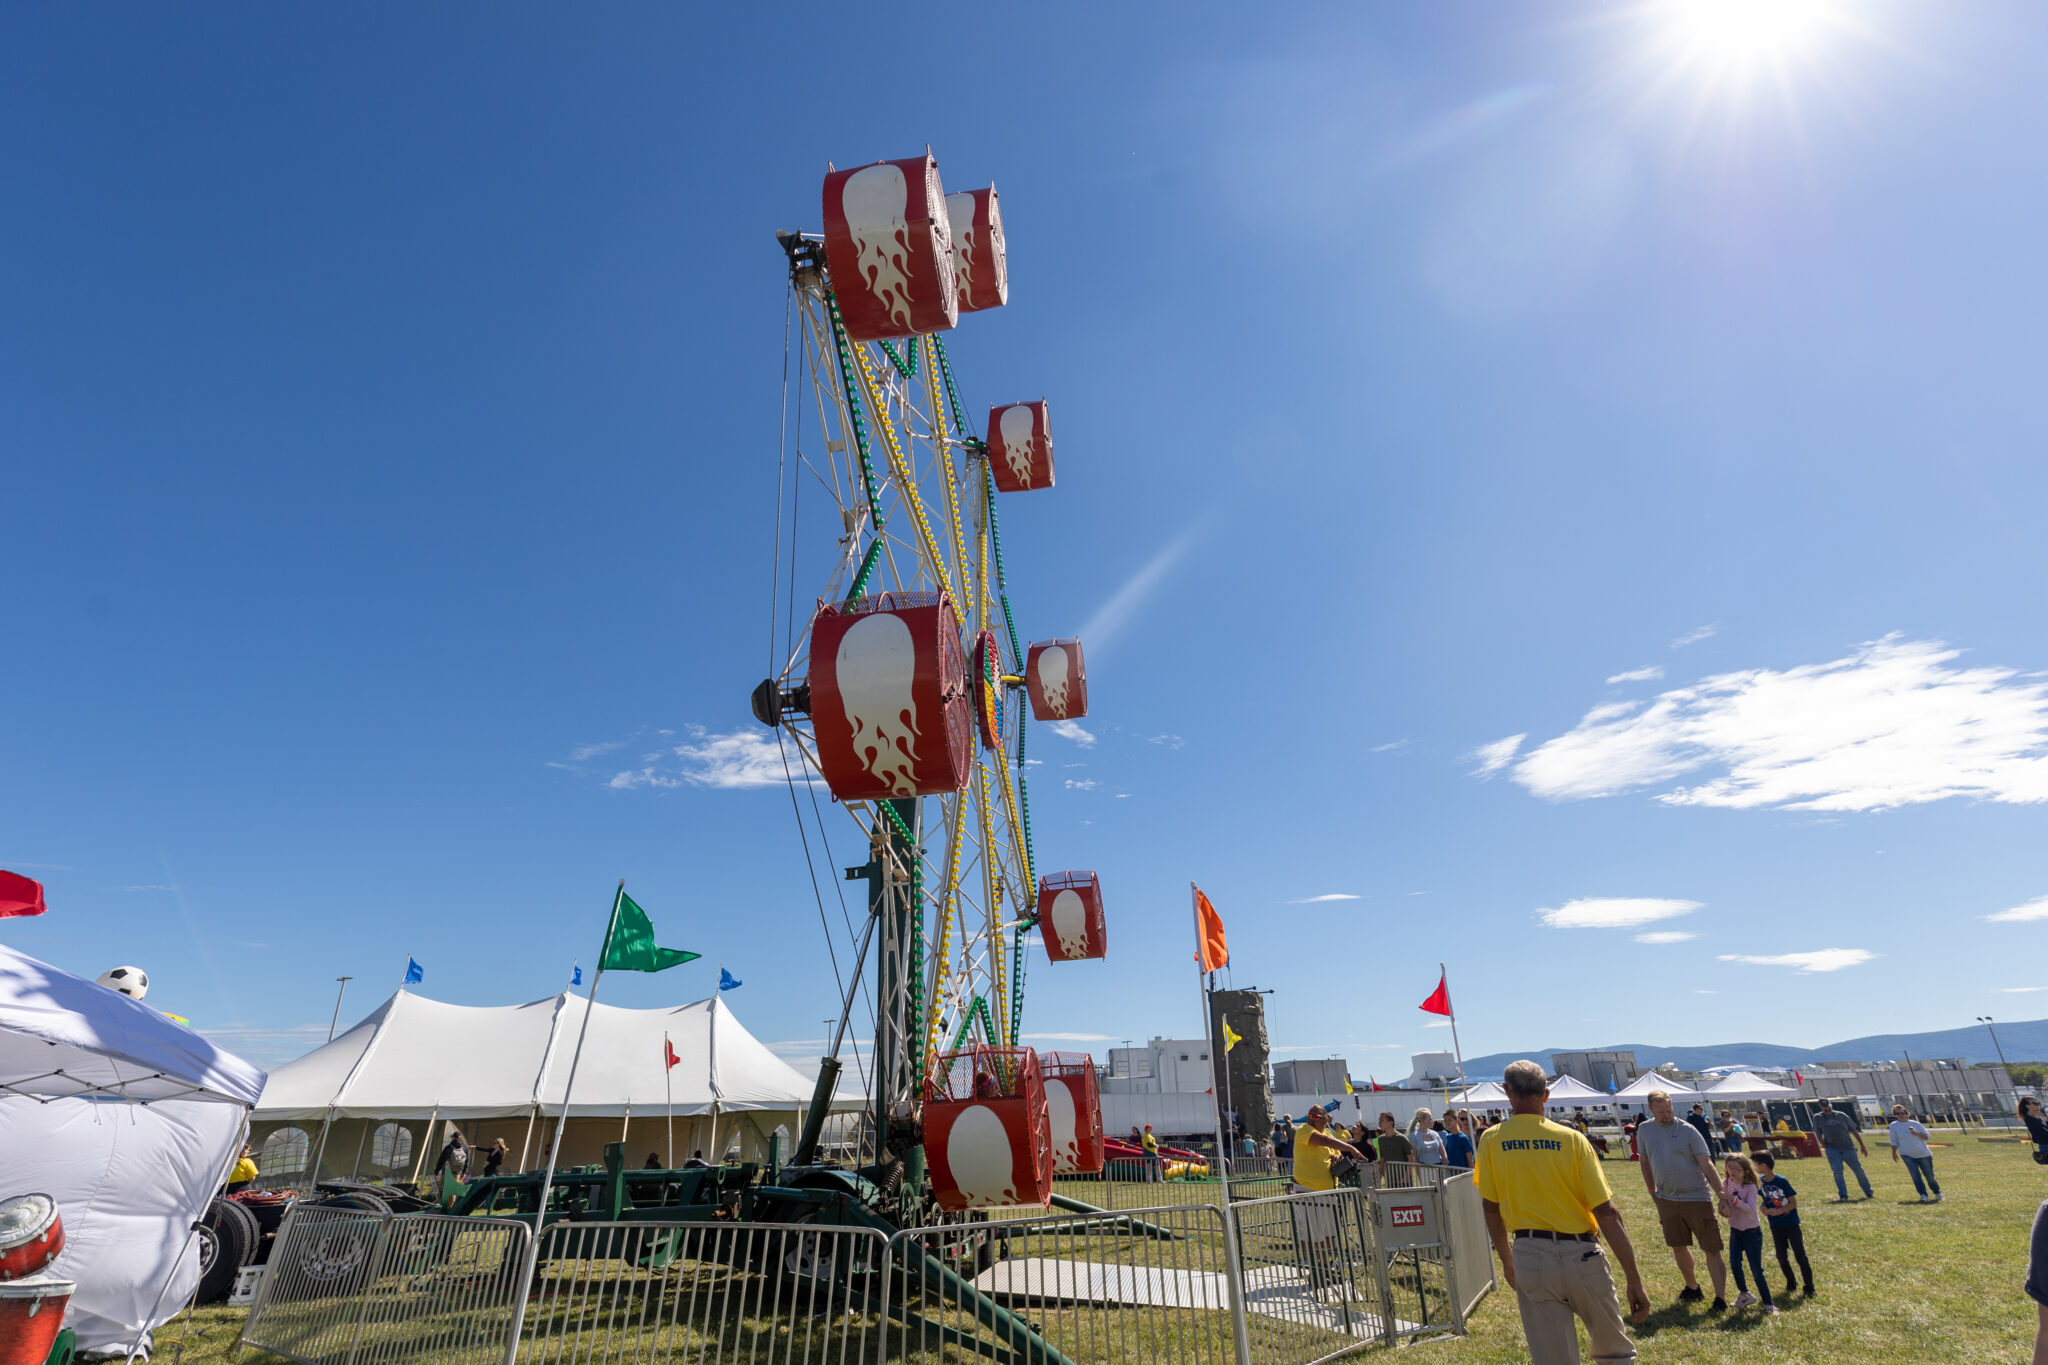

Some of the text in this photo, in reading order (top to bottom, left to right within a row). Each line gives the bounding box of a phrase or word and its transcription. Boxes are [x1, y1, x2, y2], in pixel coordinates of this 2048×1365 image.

[1501, 1139, 1562, 1151] EVENT STAFF
[1392, 1209, 1422, 1224] EXIT
